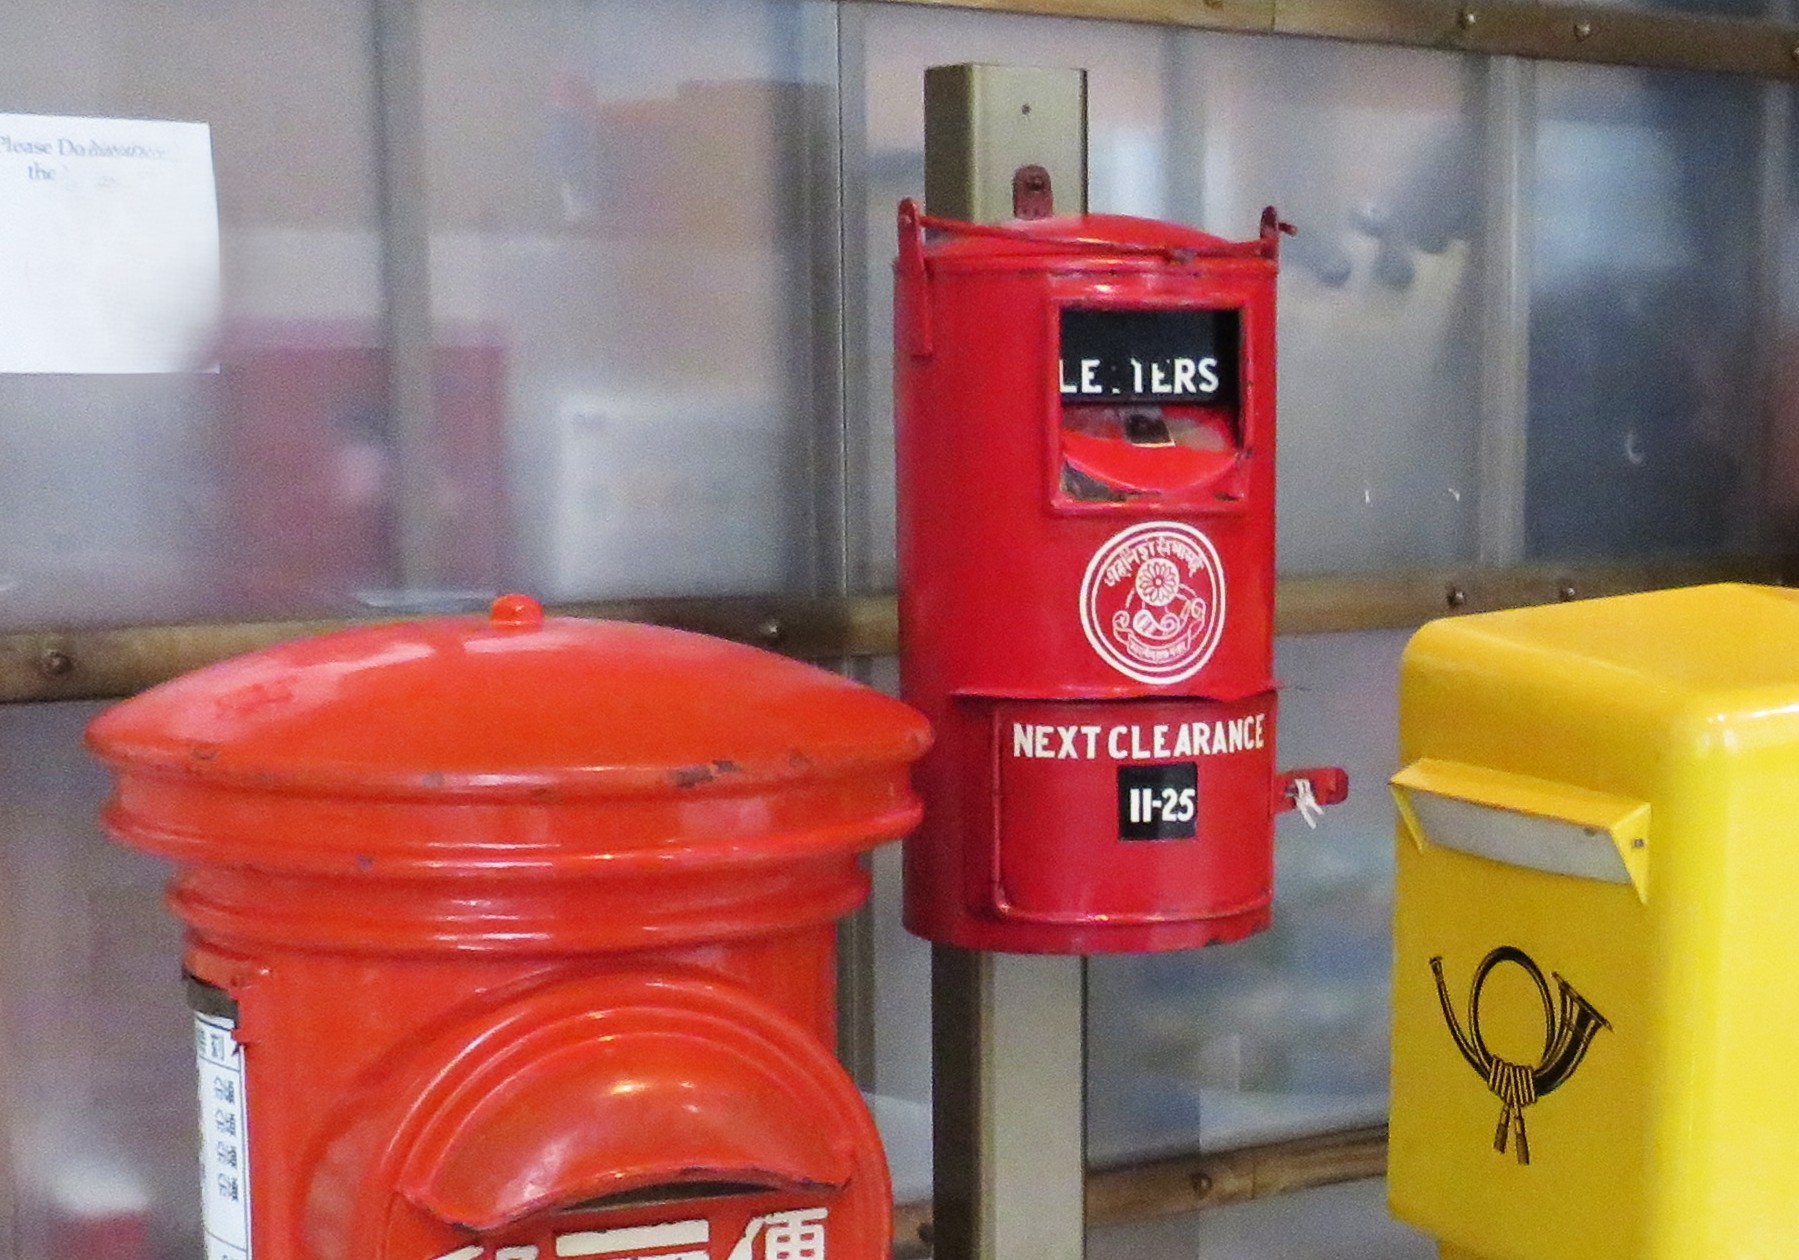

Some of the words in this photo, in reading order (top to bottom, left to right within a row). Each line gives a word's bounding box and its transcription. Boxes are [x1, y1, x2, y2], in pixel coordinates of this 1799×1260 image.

[1059, 357, 1219, 394] LETERS
[1013, 722, 1102, 759] NEXT
[1107, 713, 1266, 760] CLEARANCE
